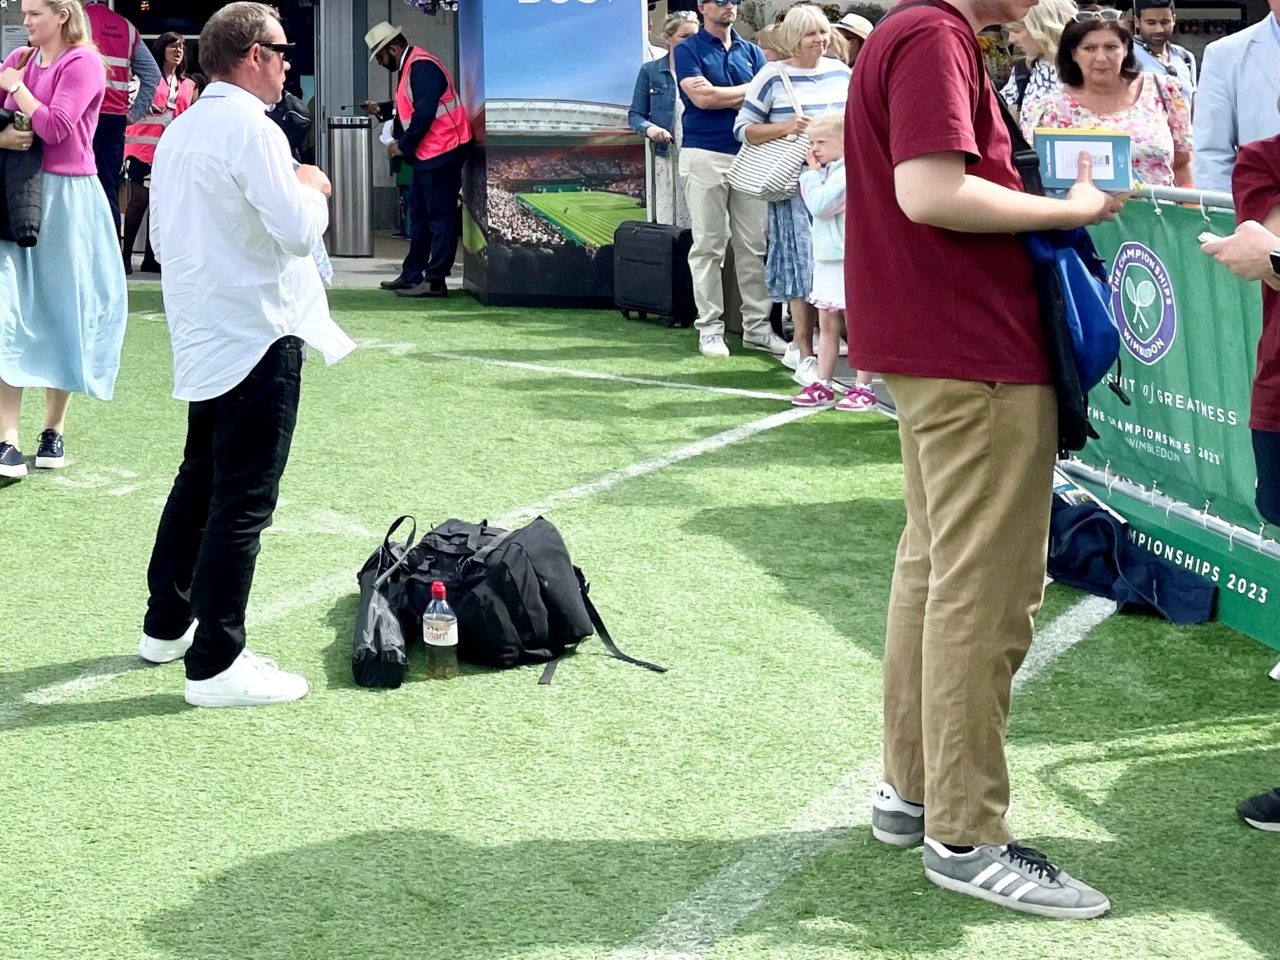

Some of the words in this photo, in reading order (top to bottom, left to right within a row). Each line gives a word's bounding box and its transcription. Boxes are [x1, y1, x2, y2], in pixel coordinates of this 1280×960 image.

[1118, 248, 1172, 306] CHAMPIONSHIPS
[1087, 406, 1105, 422] THE
[1198, 446, 1221, 466] 2023
[1157, 389, 1237, 426] GREATNESS
[1128, 528, 1221, 582] MPIONSHIPS
[1227, 573, 1268, 604] 2023
